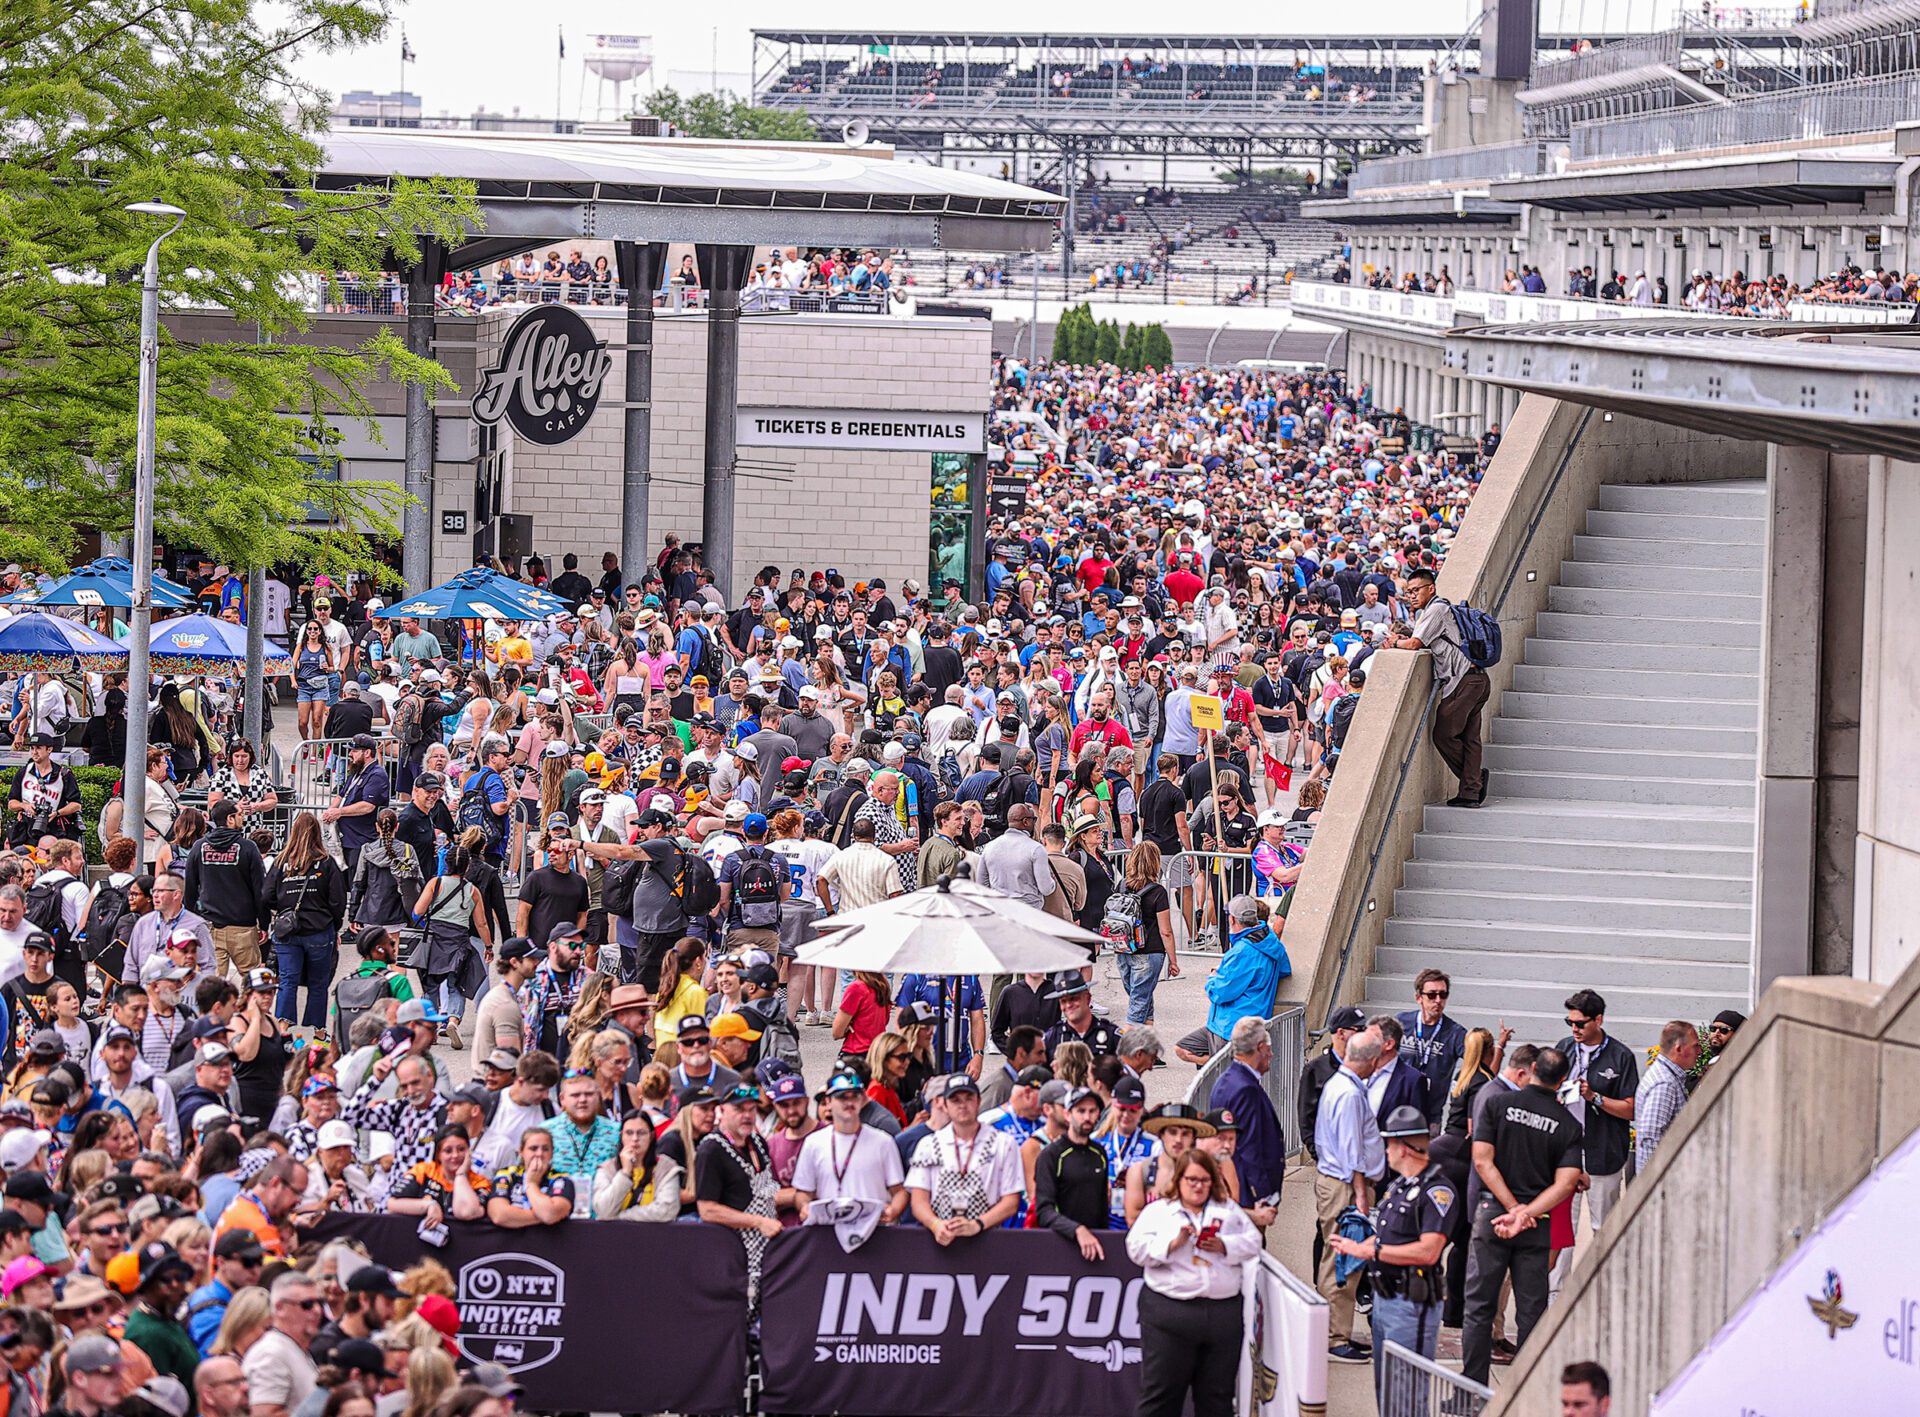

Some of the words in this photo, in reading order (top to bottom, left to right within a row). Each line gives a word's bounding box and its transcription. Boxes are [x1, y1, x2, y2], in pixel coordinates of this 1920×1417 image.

[477, 319, 611, 420] Alley
[545, 404, 585, 431] CAFÉ
[755, 419, 826, 435] TICKETS
[831, 421, 843, 435] &
[848, 421, 966, 439] CREDENTIALS
[992, 485, 1009, 493] GARAGE
[443, 515, 465, 530] 38
[24, 780, 60, 801] Caon
[1505, 1106, 1560, 1135] SECURITY
[506, 1274, 555, 1295] NTT
[459, 1304, 562, 1326] INDYCAR
[817, 1272, 1011, 1337] INDY
[478, 1322, 538, 1335] SERIES
[835, 1344, 941, 1364] GAINBRIDGE
